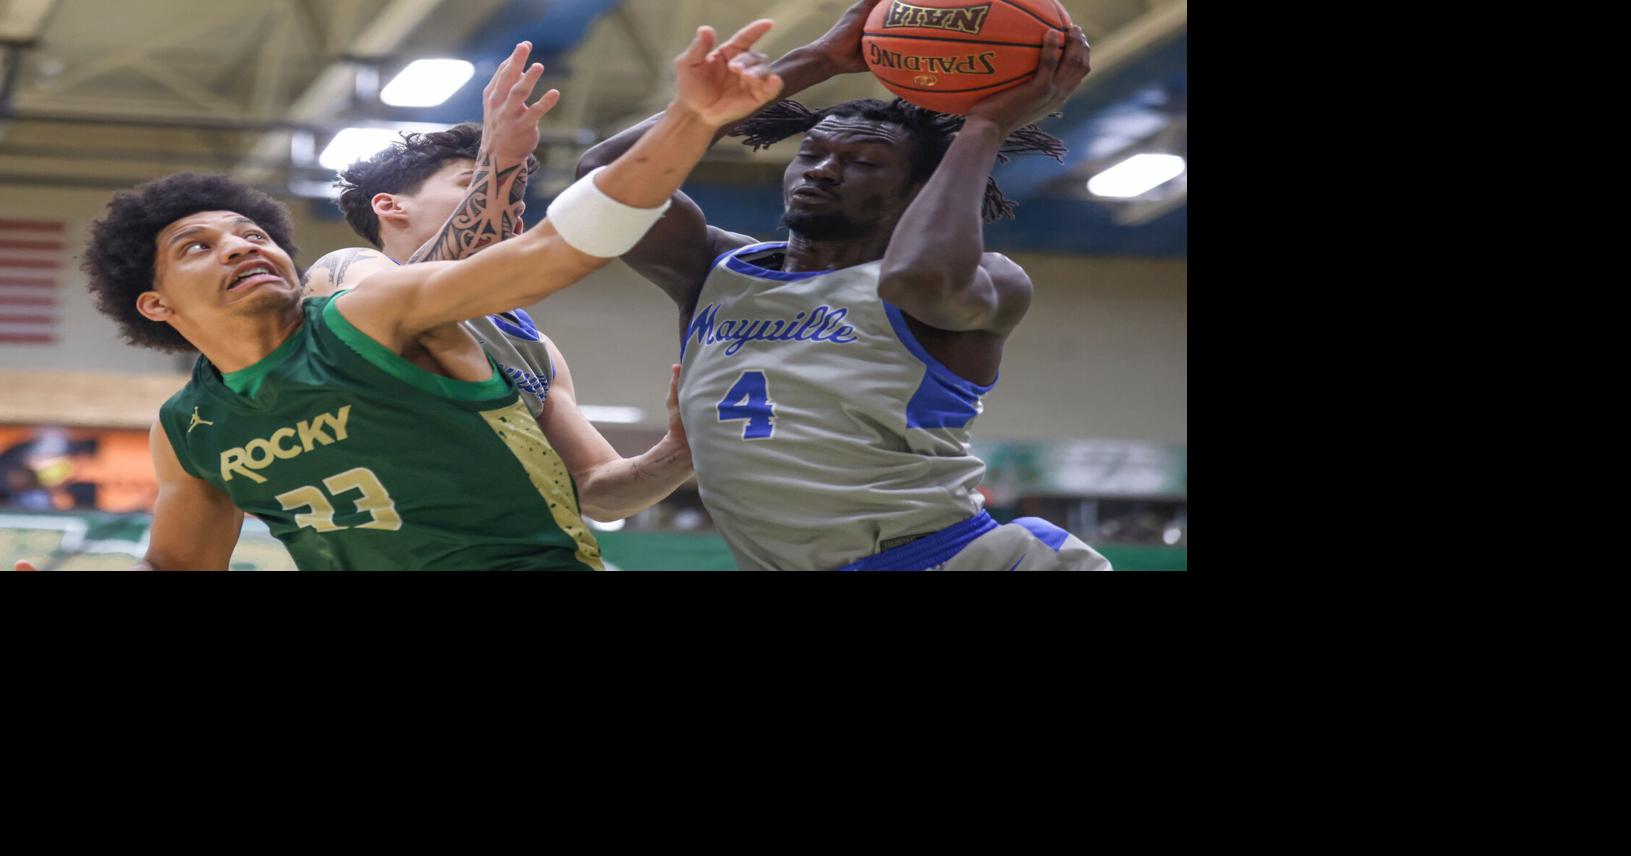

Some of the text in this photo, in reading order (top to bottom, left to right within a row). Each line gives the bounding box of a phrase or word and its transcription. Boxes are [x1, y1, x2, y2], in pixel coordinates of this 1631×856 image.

[885, 0, 991, 34] NAIA
[870, 41, 996, 75] SPALDING
[686, 303, 858, 357] Mayville
[716, 369, 777, 441] 4
[219, 404, 352, 484] ROCKY
[274, 467, 403, 532] 33
